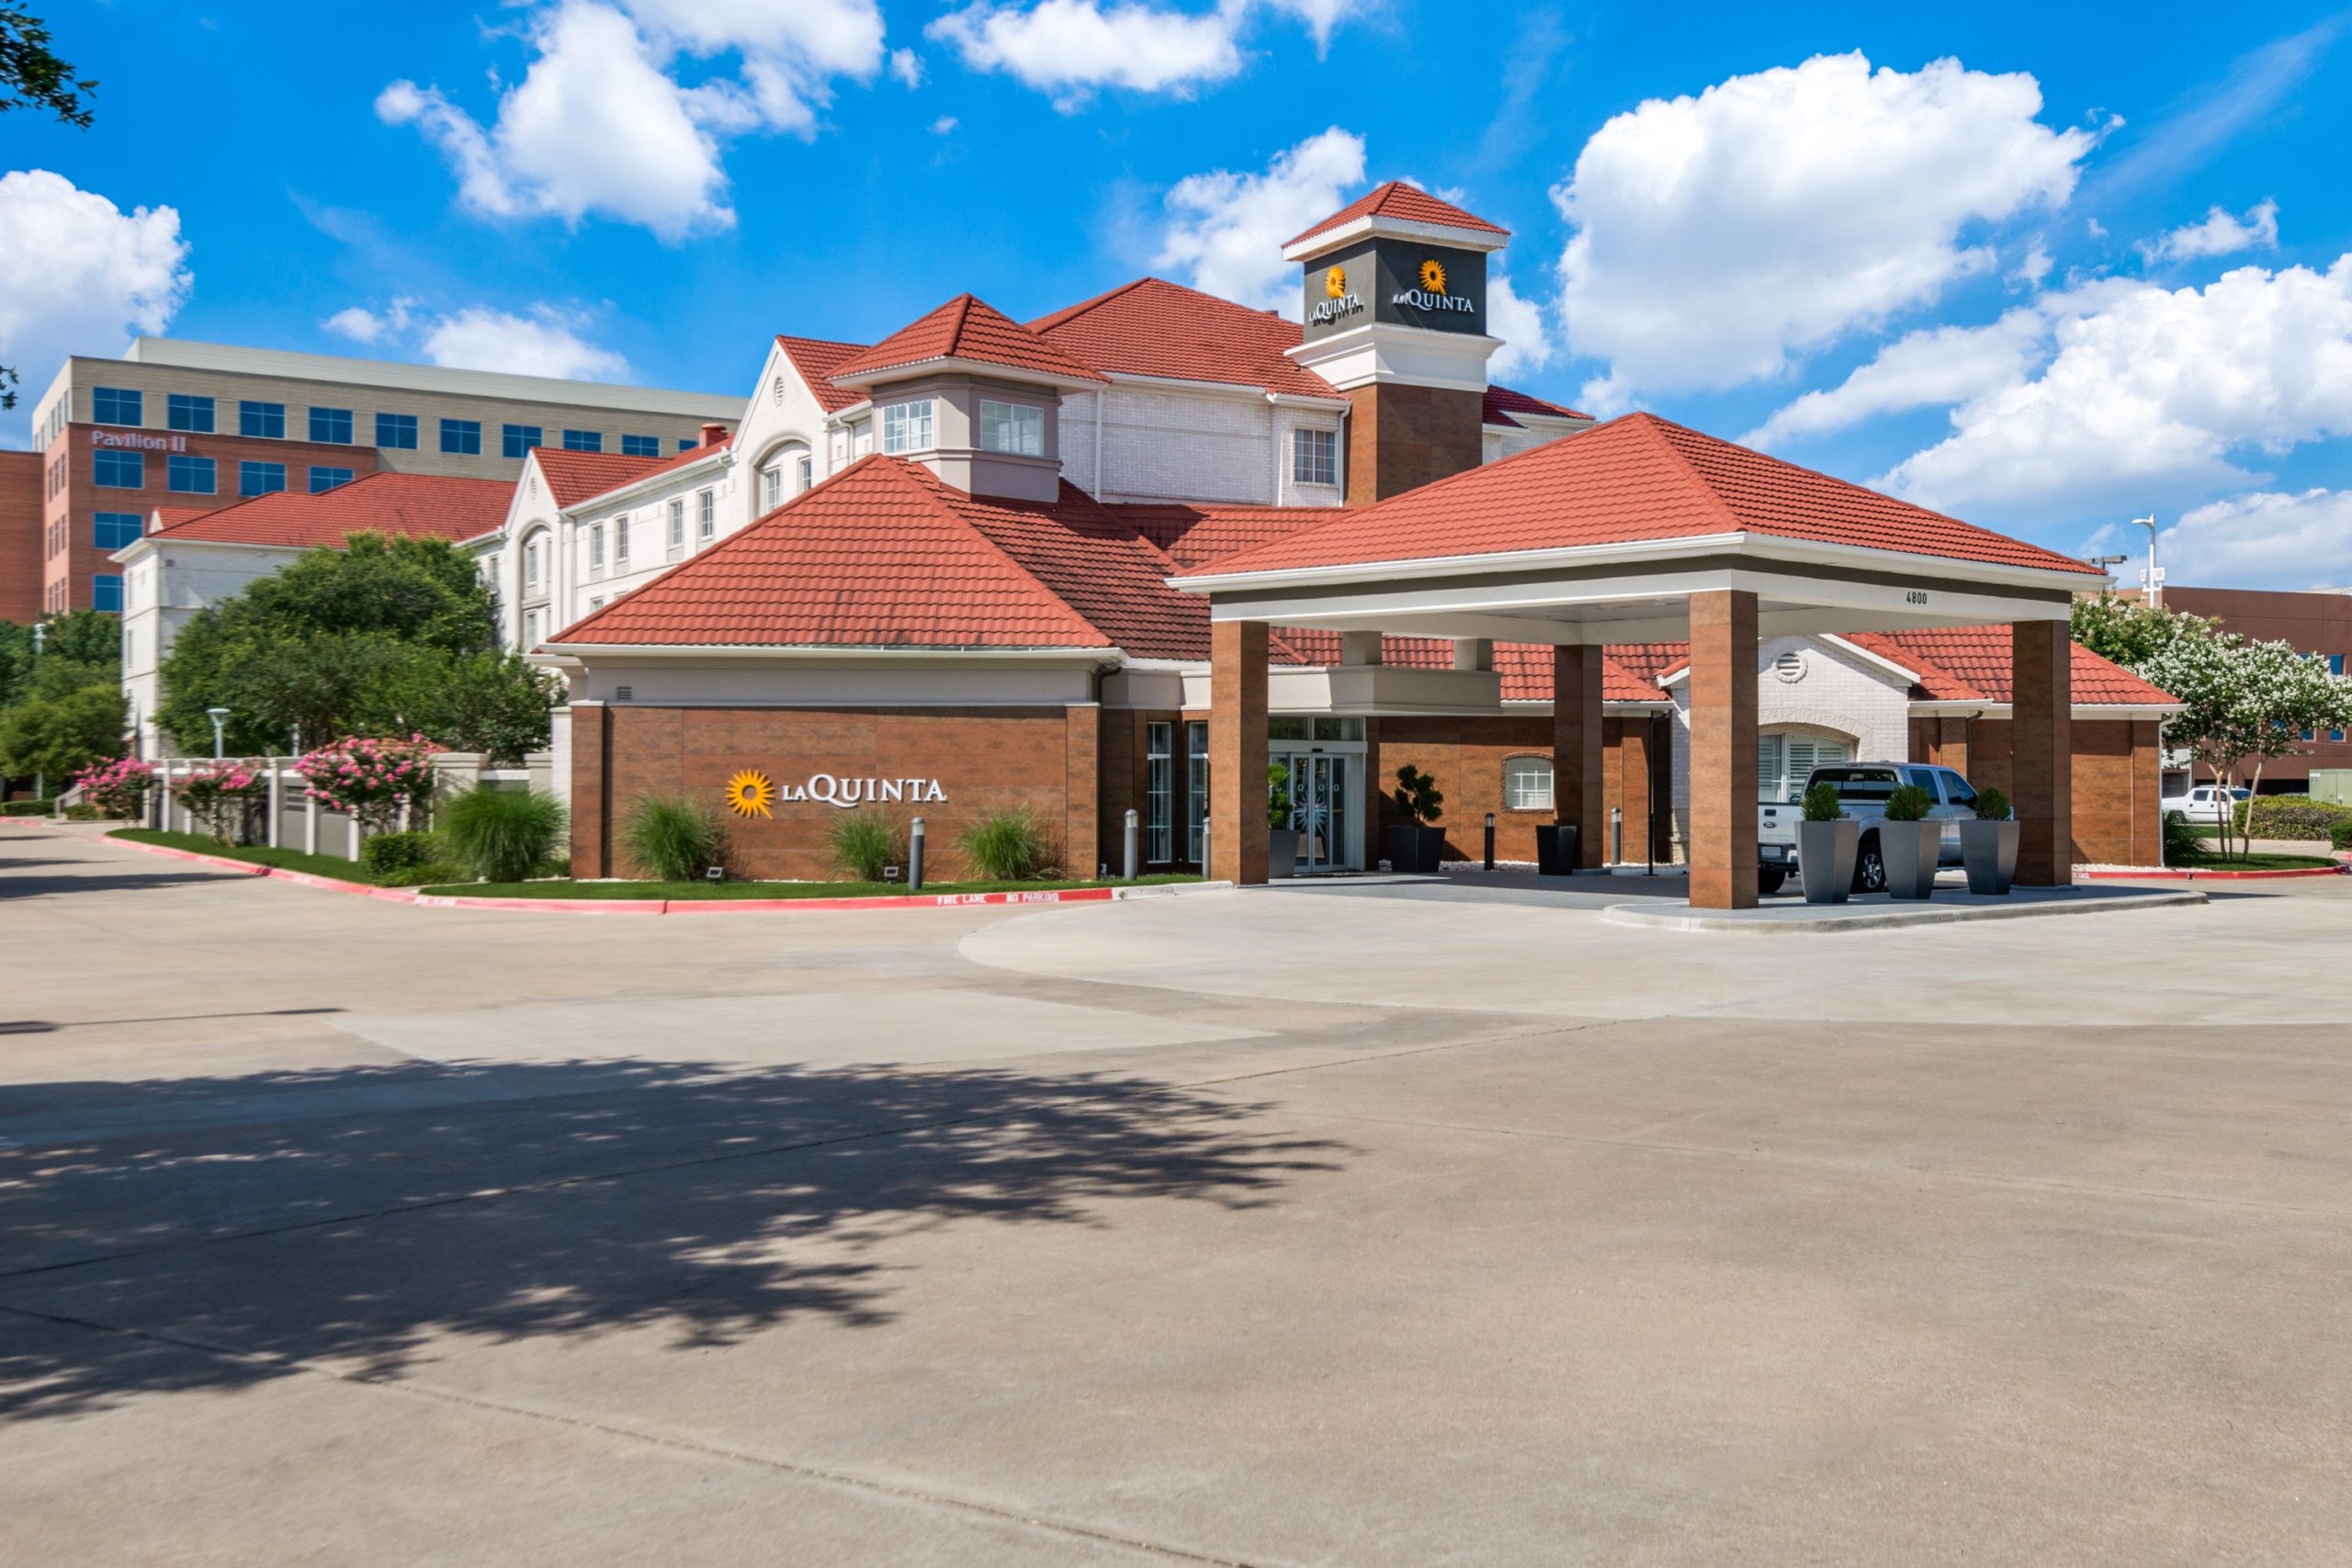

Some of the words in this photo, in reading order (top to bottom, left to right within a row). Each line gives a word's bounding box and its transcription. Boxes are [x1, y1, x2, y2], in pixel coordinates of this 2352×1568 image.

[92, 430, 167, 450] Pavilion
[1906, 591, 1928, 604] 4800
[937, 896, 958, 906] FIRE
[962, 894, 987, 904] LANE
[1006, 892, 1019, 903] NO
[1022, 892, 1059, 903] PARKING
